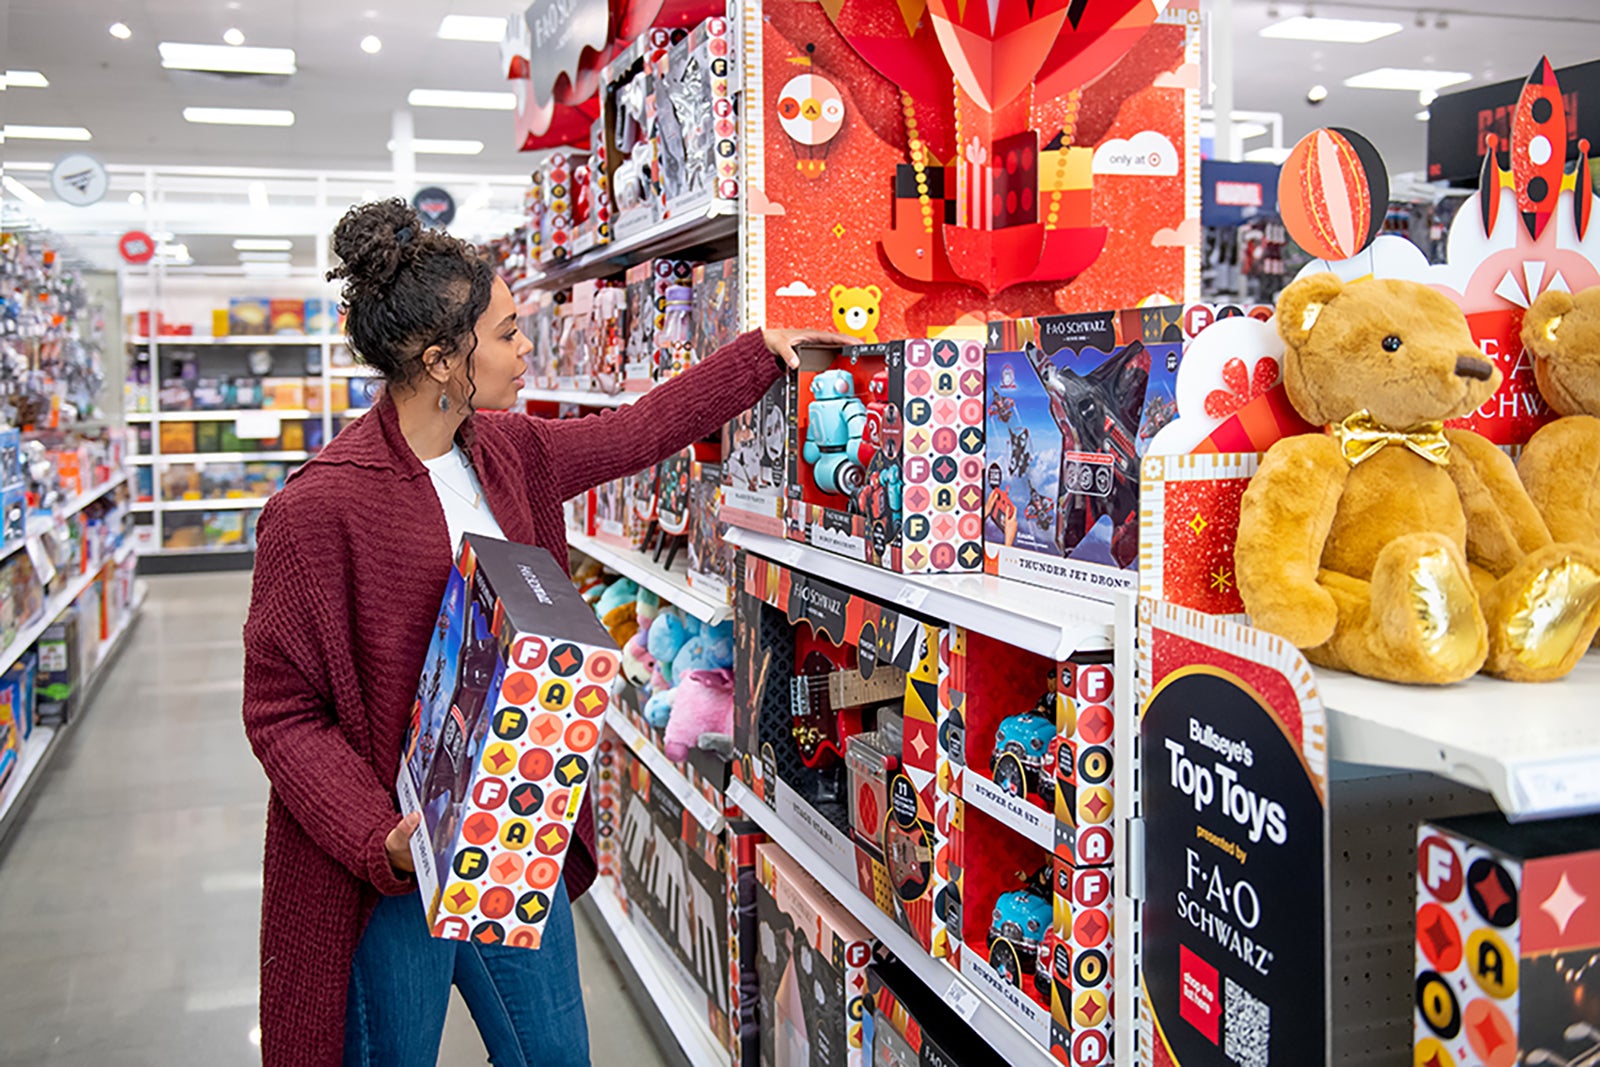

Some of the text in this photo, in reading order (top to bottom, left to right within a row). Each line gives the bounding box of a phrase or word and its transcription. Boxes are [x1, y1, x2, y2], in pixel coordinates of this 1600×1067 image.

[1109, 154, 1146, 167] only at
[1191, 310, 1208, 334] F
[912, 345, 925, 363] F
[965, 343, 980, 360] O
[938, 374, 952, 390] A
[911, 402, 925, 420] F
[868, 419, 879, 443] 2
[938, 433, 952, 450] A
[911, 459, 925, 479] F
[963, 460, 979, 478] O
[937, 490, 950, 507] A
[910, 518, 923, 537] F
[936, 548, 950, 566] A
[1019, 558, 1067, 578] THUNDER
[1070, 569, 1089, 581] JET
[518, 641, 612, 678] F O
[545, 683, 566, 705] A
[1087, 671, 1105, 698] F
[498, 711, 522, 734] F
[1189, 717, 1254, 768] Bullseye's
[528, 753, 548, 776] A
[1085, 752, 1107, 778] O
[479, 781, 502, 805] F
[897, 782, 908, 797] 11
[1164, 738, 1215, 812] Top
[1214, 762, 1288, 845] Toys
[1007, 802, 1024, 817] CAR
[505, 822, 527, 844] A
[1085, 833, 1106, 859] A
[1235, 845, 1248, 865] by
[459, 852, 483, 875] F
[1427, 843, 1453, 890] F
[1083, 875, 1100, 902] F
[489, 891, 510, 914] A
[852, 946, 865, 964] F
[1478, 940, 1504, 987] A
[1080, 955, 1101, 982] O
[1003, 989, 1020, 1007] CAR
[1422, 980, 1454, 1029] O
[1080, 1035, 1100, 1062] A
